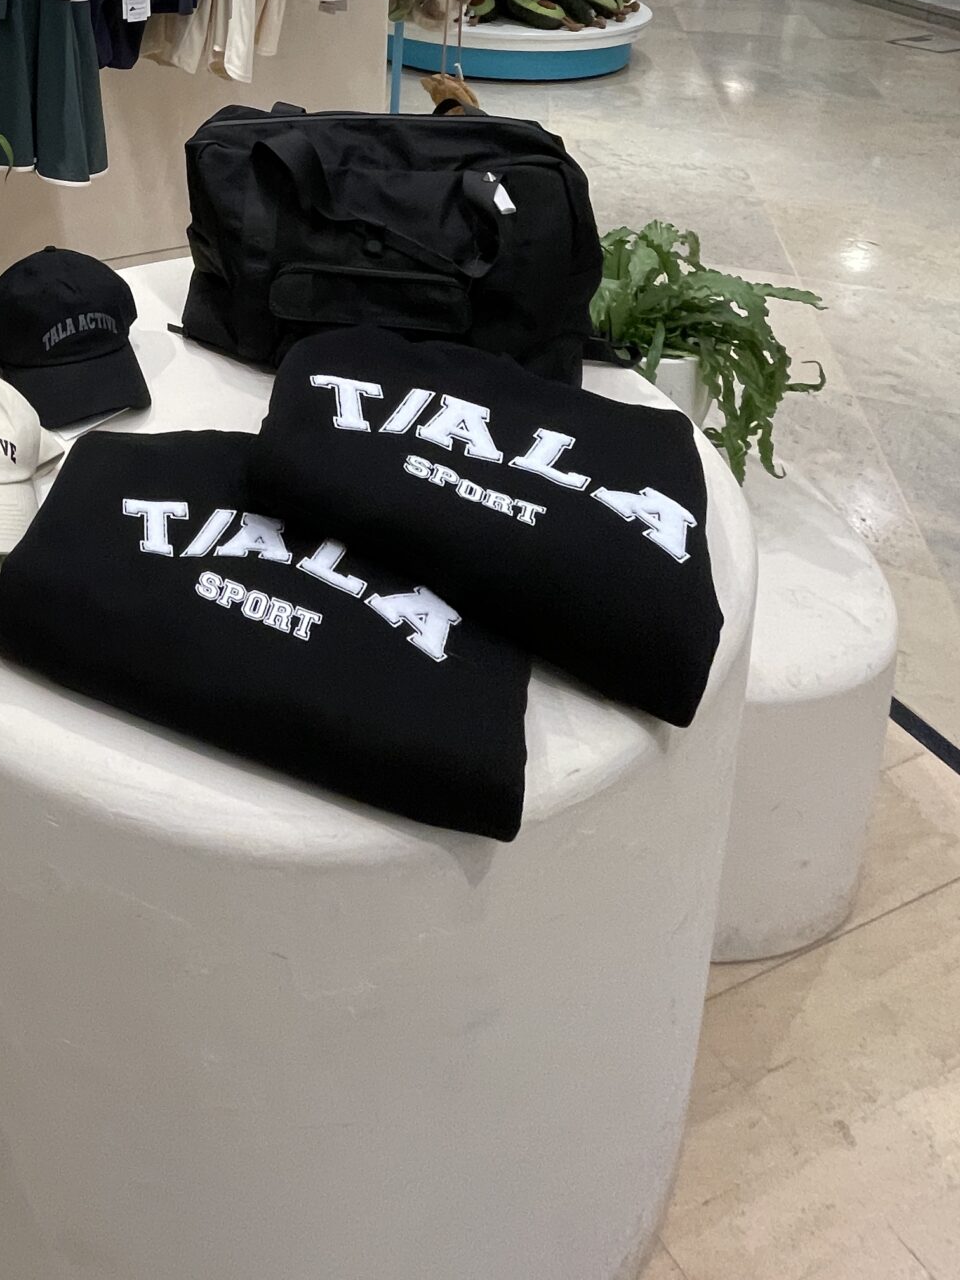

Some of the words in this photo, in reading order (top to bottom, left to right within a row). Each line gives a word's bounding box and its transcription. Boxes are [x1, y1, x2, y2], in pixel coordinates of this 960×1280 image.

[42, 318, 76, 351] TALA
[403, 454, 546, 526] SPORT
[195, 570, 323, 641] SPORT
